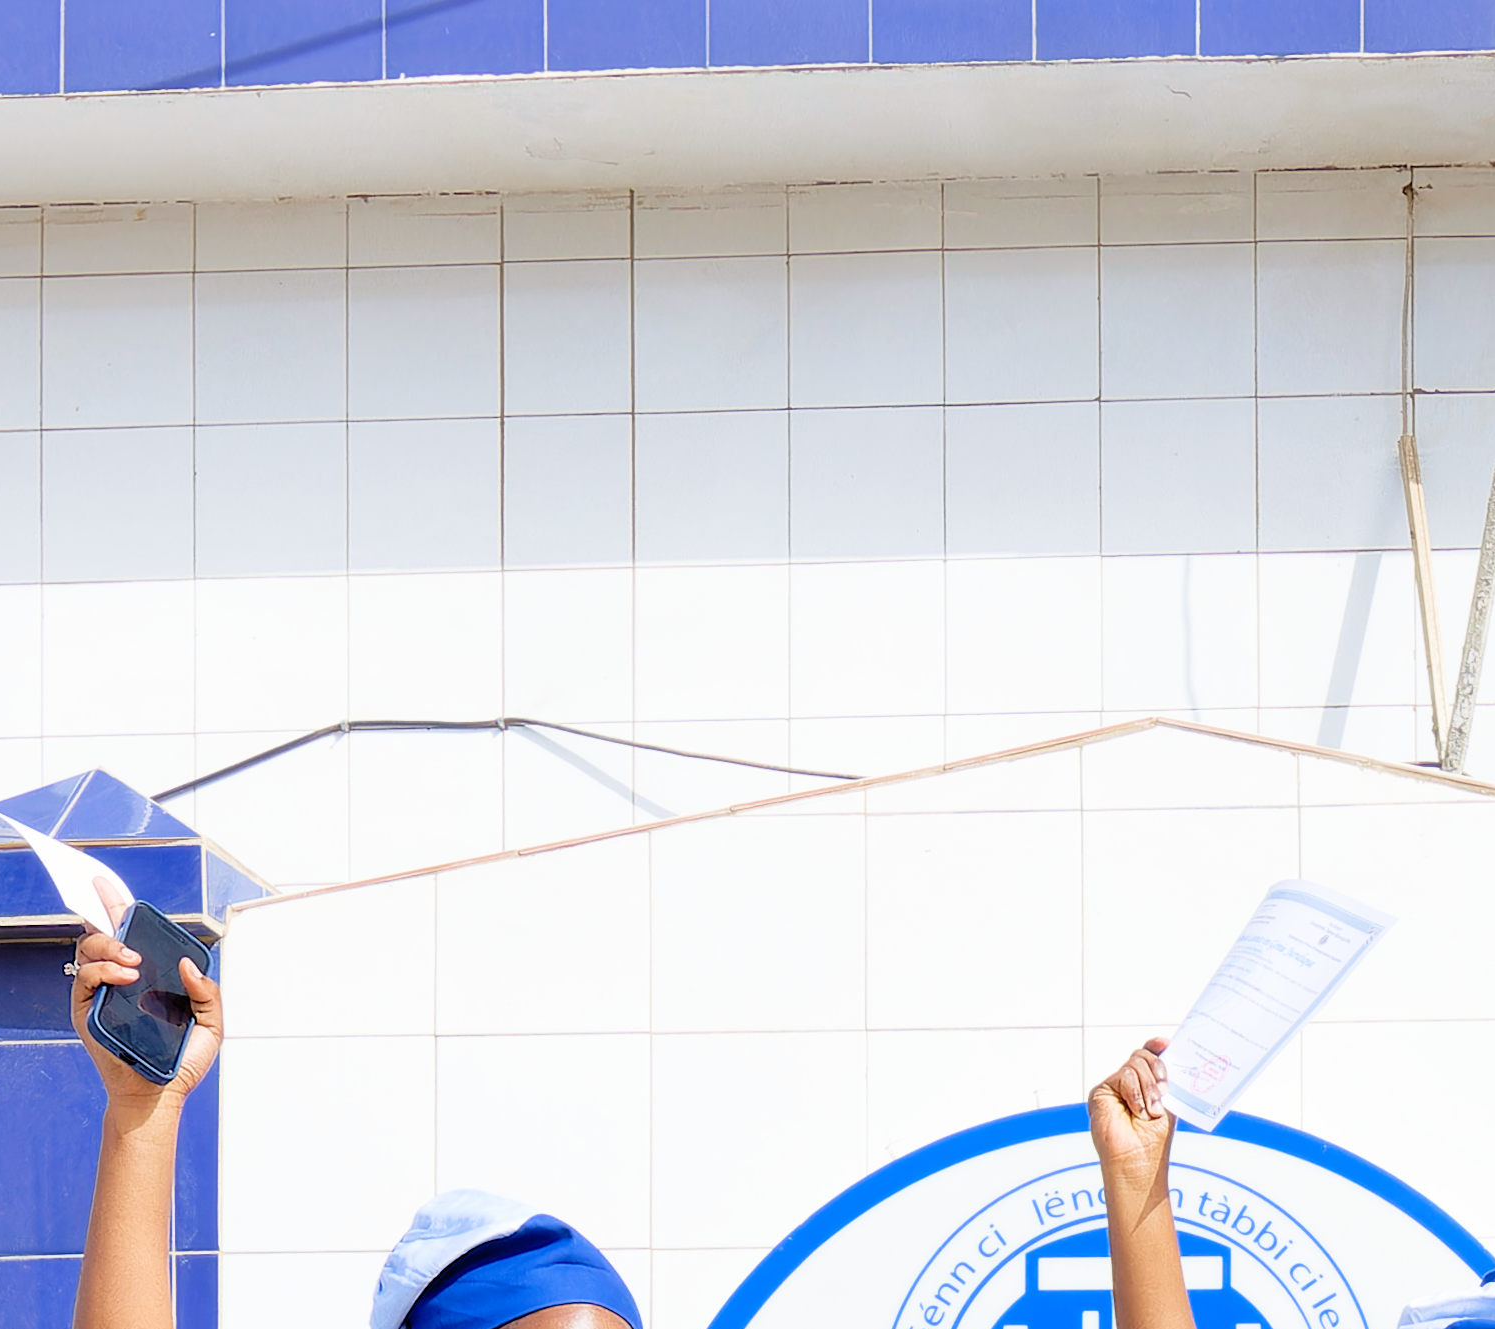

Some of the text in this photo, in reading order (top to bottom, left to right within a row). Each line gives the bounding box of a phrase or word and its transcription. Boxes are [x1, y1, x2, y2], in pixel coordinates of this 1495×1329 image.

[978, 1224, 1007, 1258] ci
[1197, 1192, 1293, 1260] tàbbi
[1289, 1263, 1324, 1291] ci
